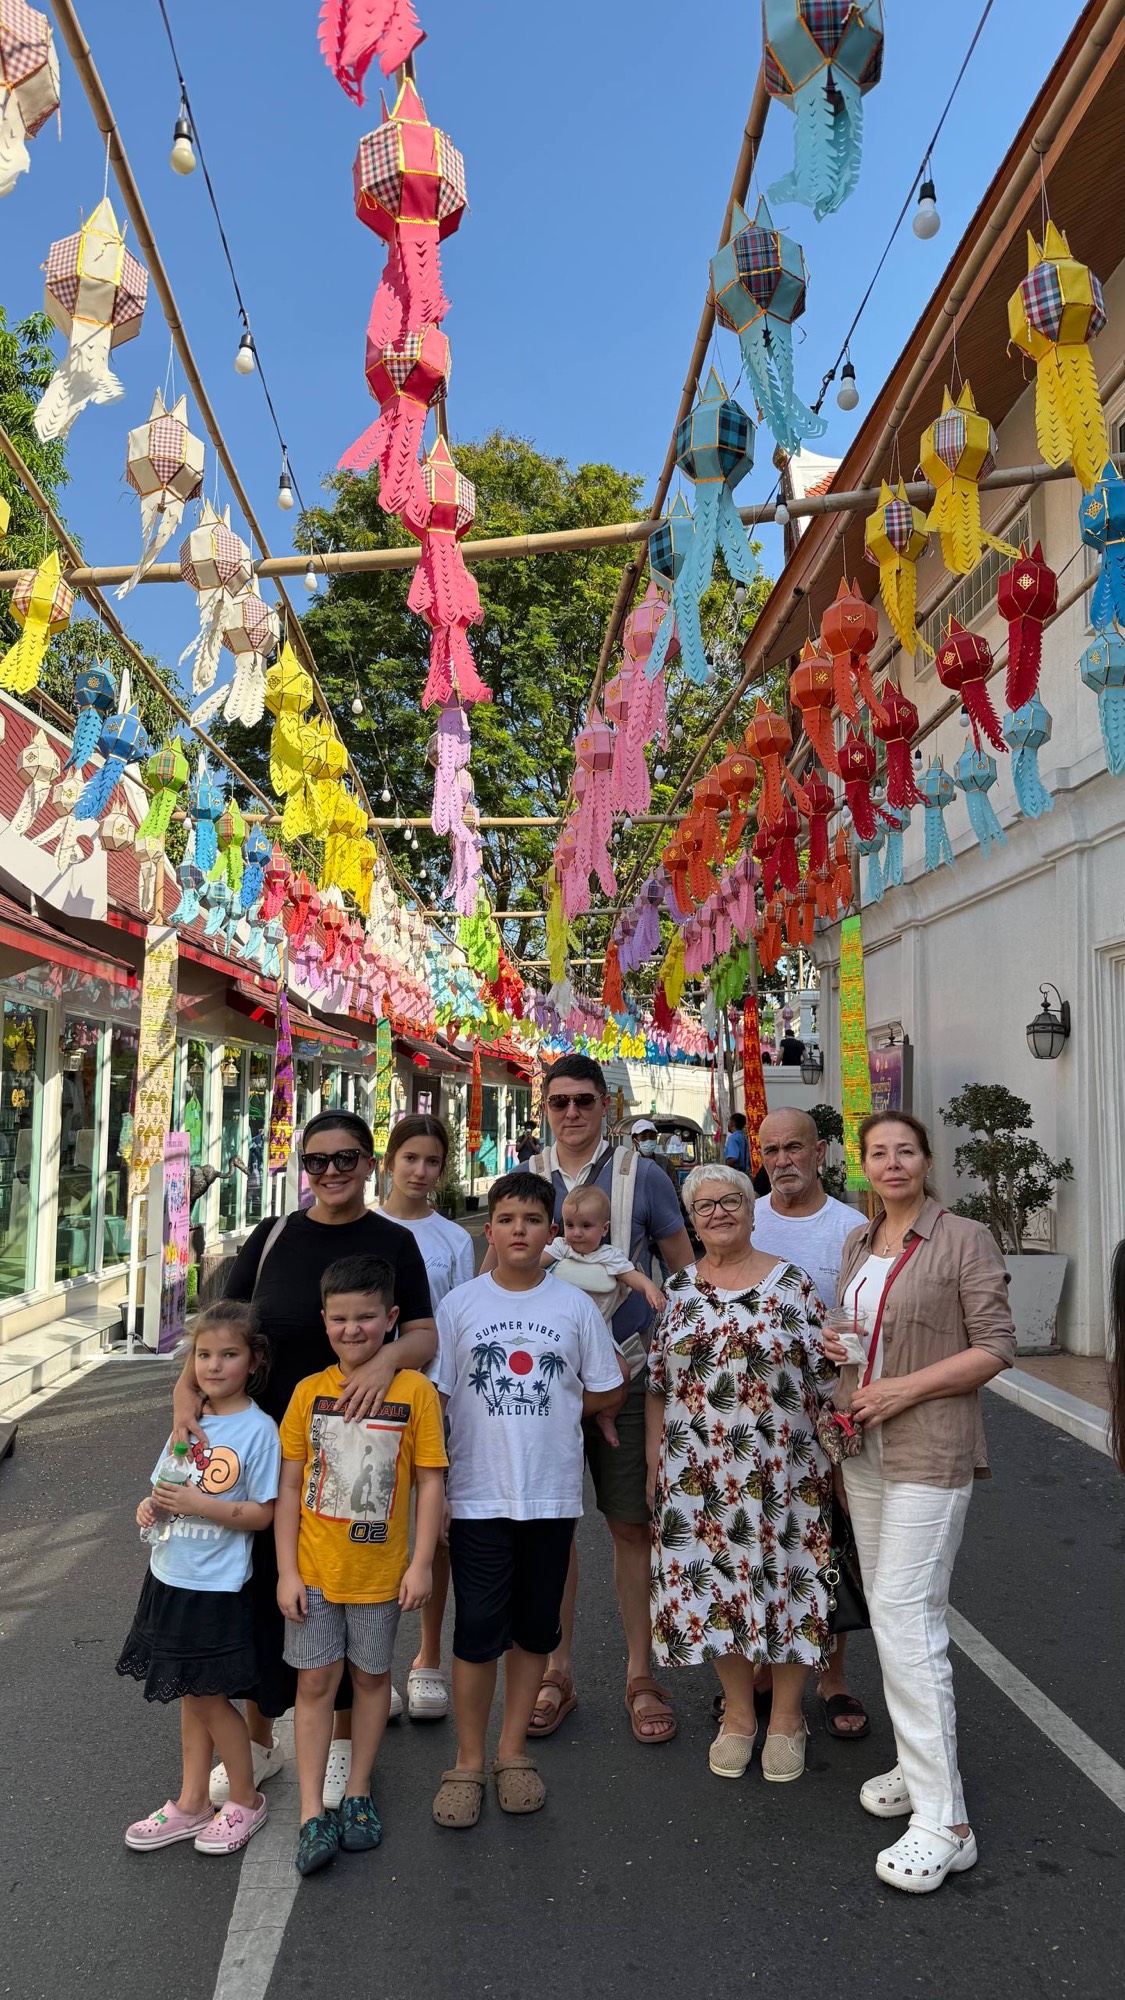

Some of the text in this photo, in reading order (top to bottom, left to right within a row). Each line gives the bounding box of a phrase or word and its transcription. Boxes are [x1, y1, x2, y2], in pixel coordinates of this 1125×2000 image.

[475, 1321, 561, 1342] SUMMER VIBES
[488, 1405, 550, 1417] MALDIVES
[172, 1521, 224, 1540] KITTY
[350, 1520, 388, 1544] 02
